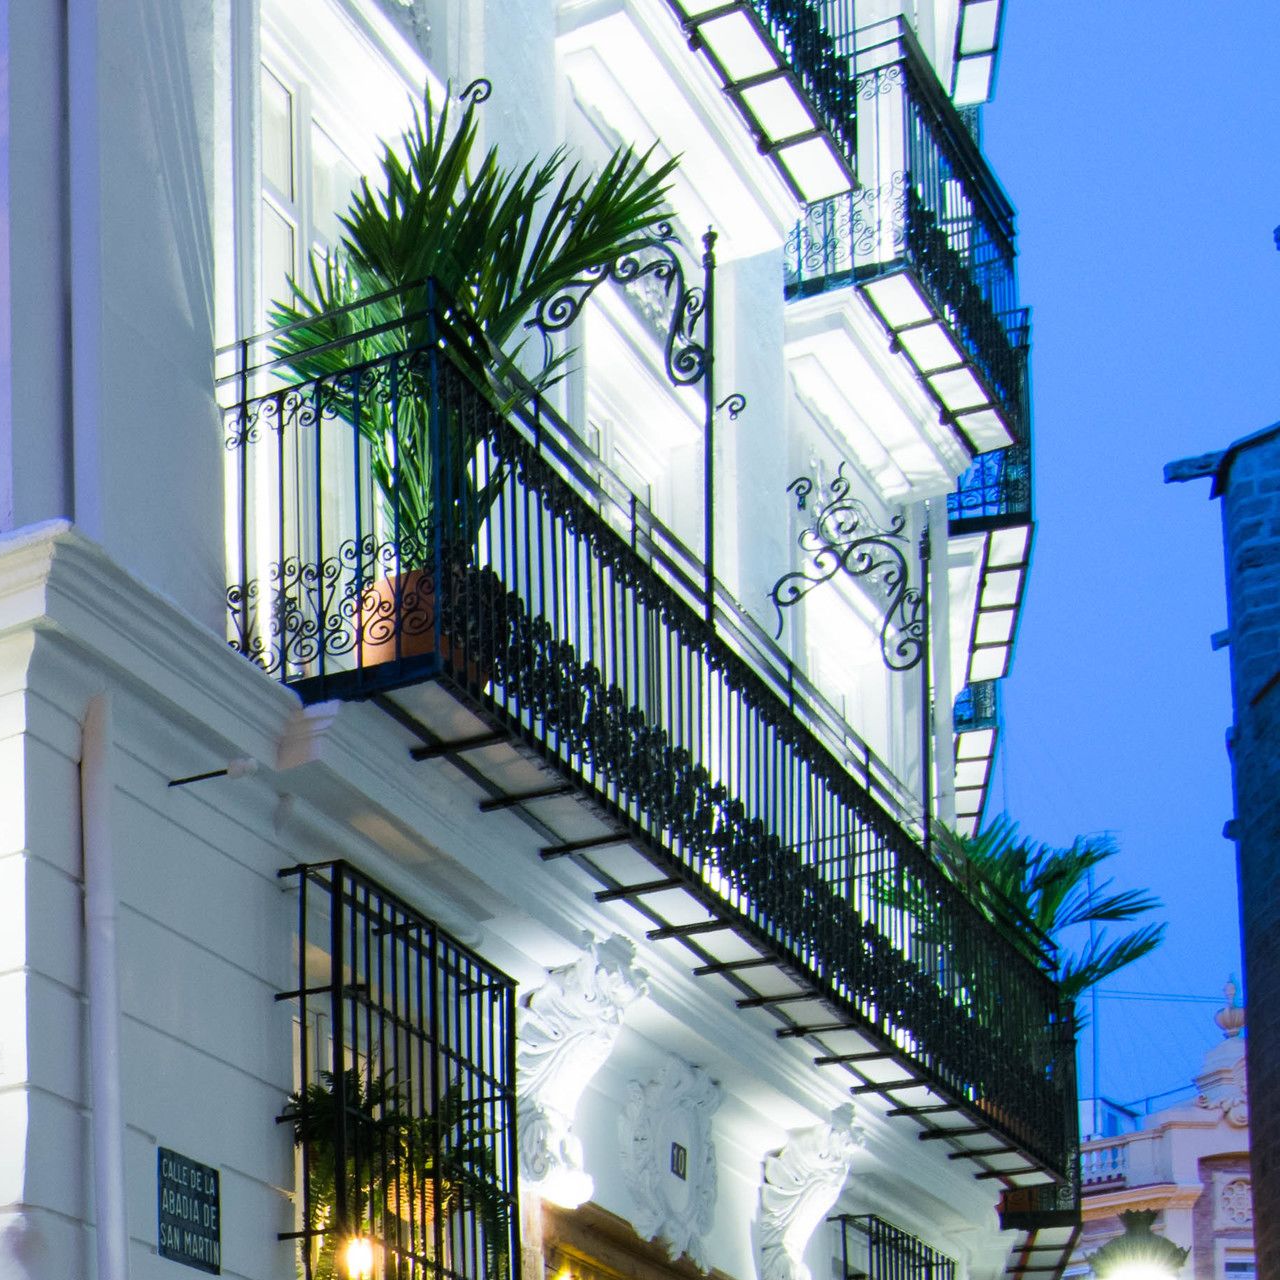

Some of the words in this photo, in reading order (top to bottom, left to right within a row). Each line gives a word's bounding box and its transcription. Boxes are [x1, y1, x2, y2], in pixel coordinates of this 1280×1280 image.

[162, 1158, 188, 1186] CALLE
[190, 1169, 202, 1191] DE
[204, 1175, 215, 1197] LA
[162, 1188, 200, 1225] ABADIA
[203, 1204, 217, 1230] DE
[160, 1222, 180, 1252] SAN
[184, 1231, 220, 1265] MARTIN
